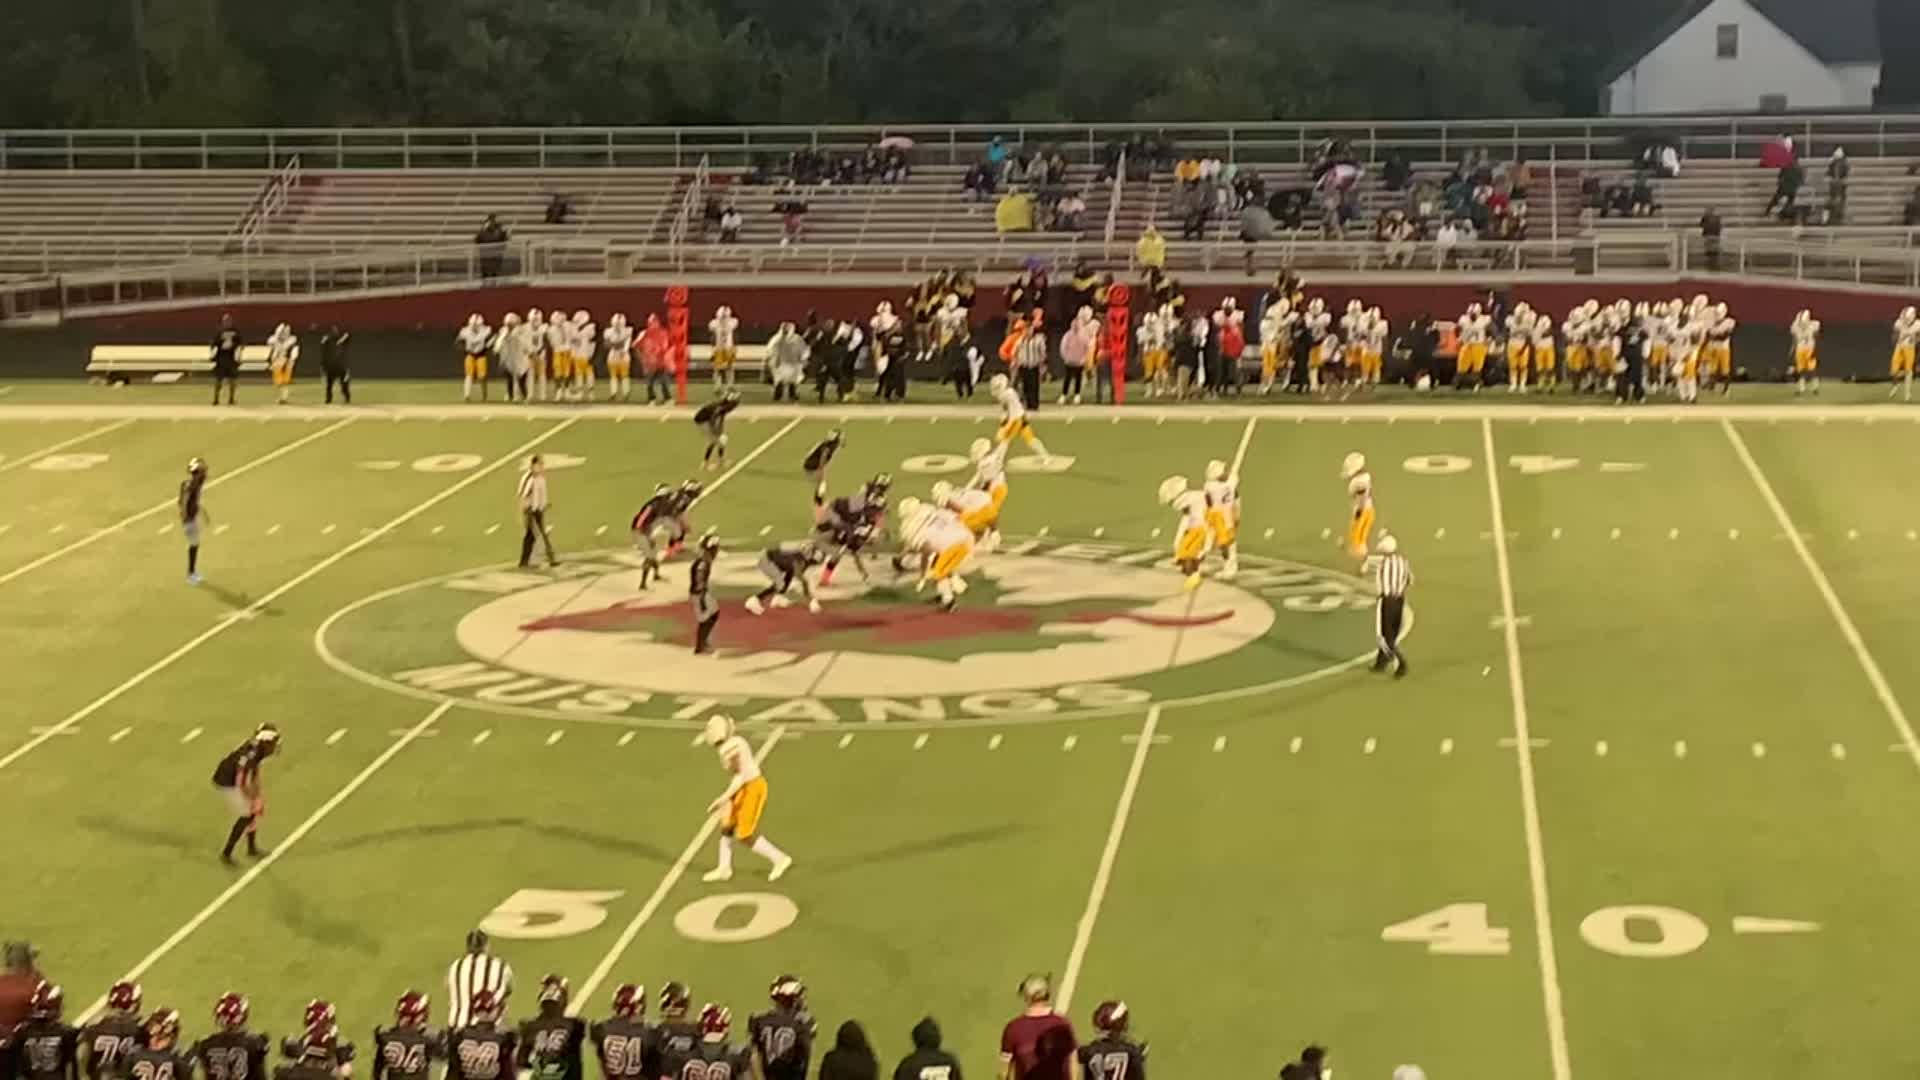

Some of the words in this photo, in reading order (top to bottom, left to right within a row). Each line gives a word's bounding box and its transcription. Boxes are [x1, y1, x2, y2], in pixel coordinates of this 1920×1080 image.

[391, 660, 1153, 724] MUSTANGS
[478, 887, 800, 944] 50
[1381, 902, 1709, 958] 40
[603, 1034, 643, 1076] 51
